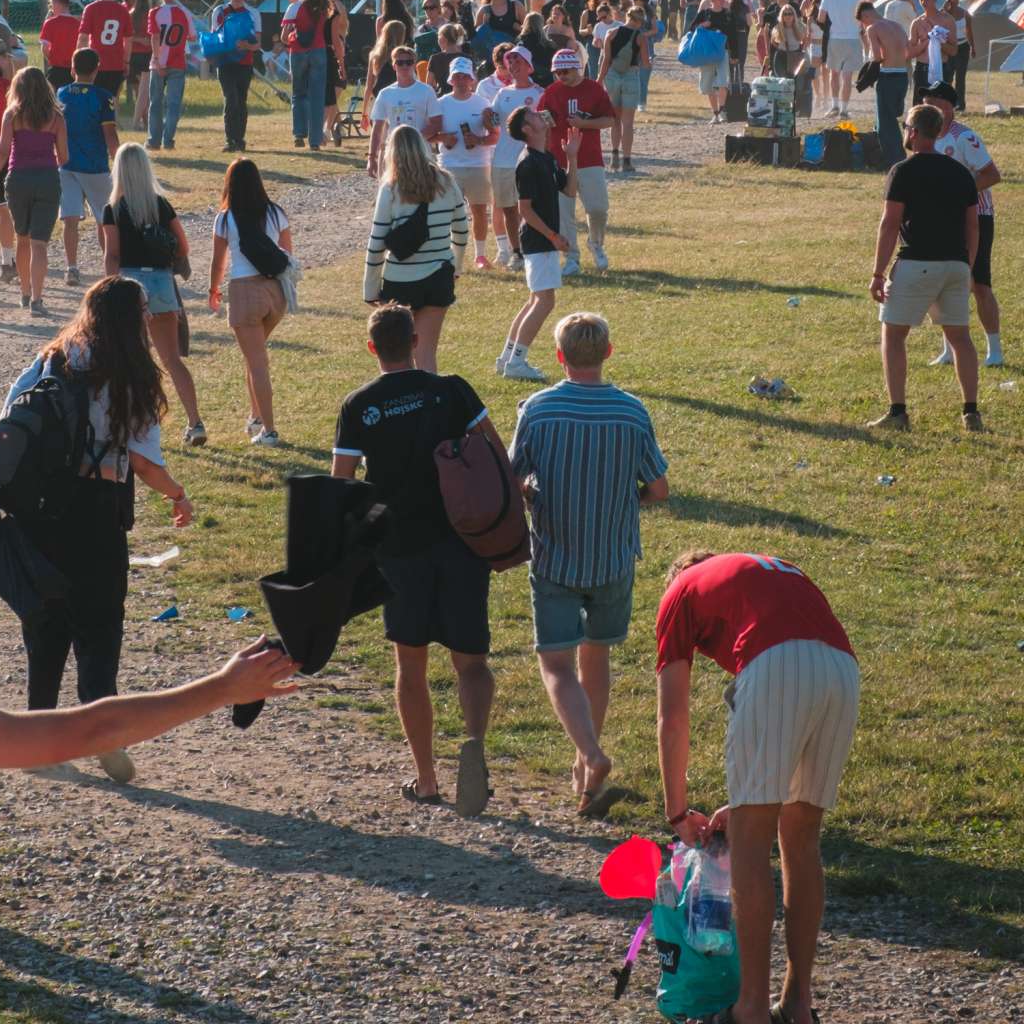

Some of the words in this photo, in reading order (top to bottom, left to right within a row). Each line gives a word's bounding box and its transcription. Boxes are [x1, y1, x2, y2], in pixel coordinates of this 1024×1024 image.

[100, 19, 120, 46] 8
[159, 23, 184, 47] 10
[568, 98, 578, 116] 10
